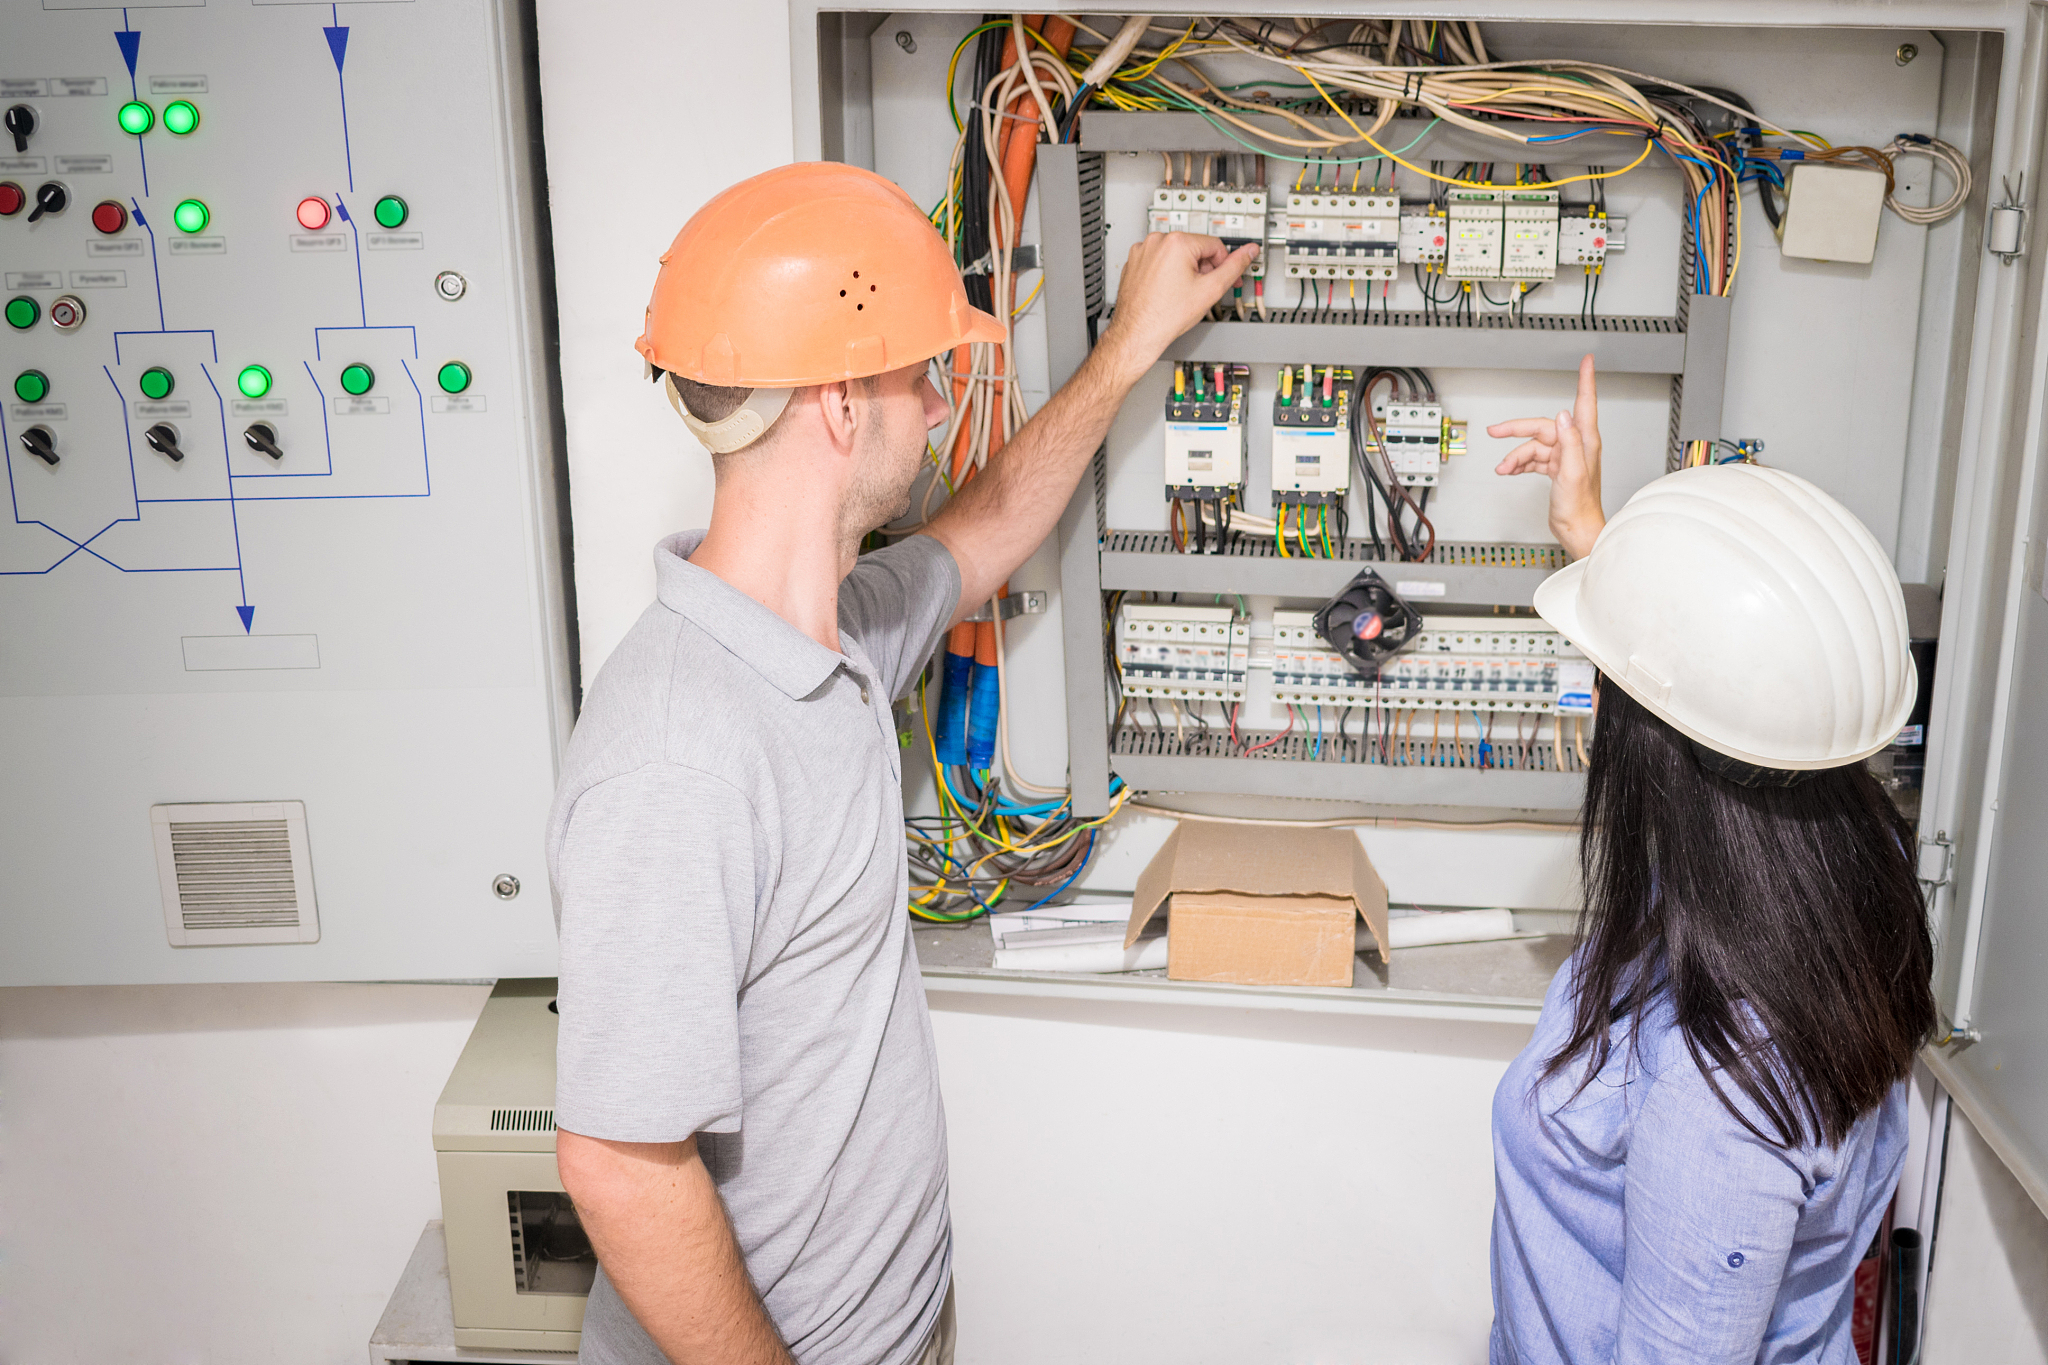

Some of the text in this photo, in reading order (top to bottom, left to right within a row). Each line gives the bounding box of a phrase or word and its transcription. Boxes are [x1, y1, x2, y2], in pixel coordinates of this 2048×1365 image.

[1231, 217, 1238, 225] 2
[1311, 221, 1318, 229] 3
[1368, 222, 1375, 230] 4
